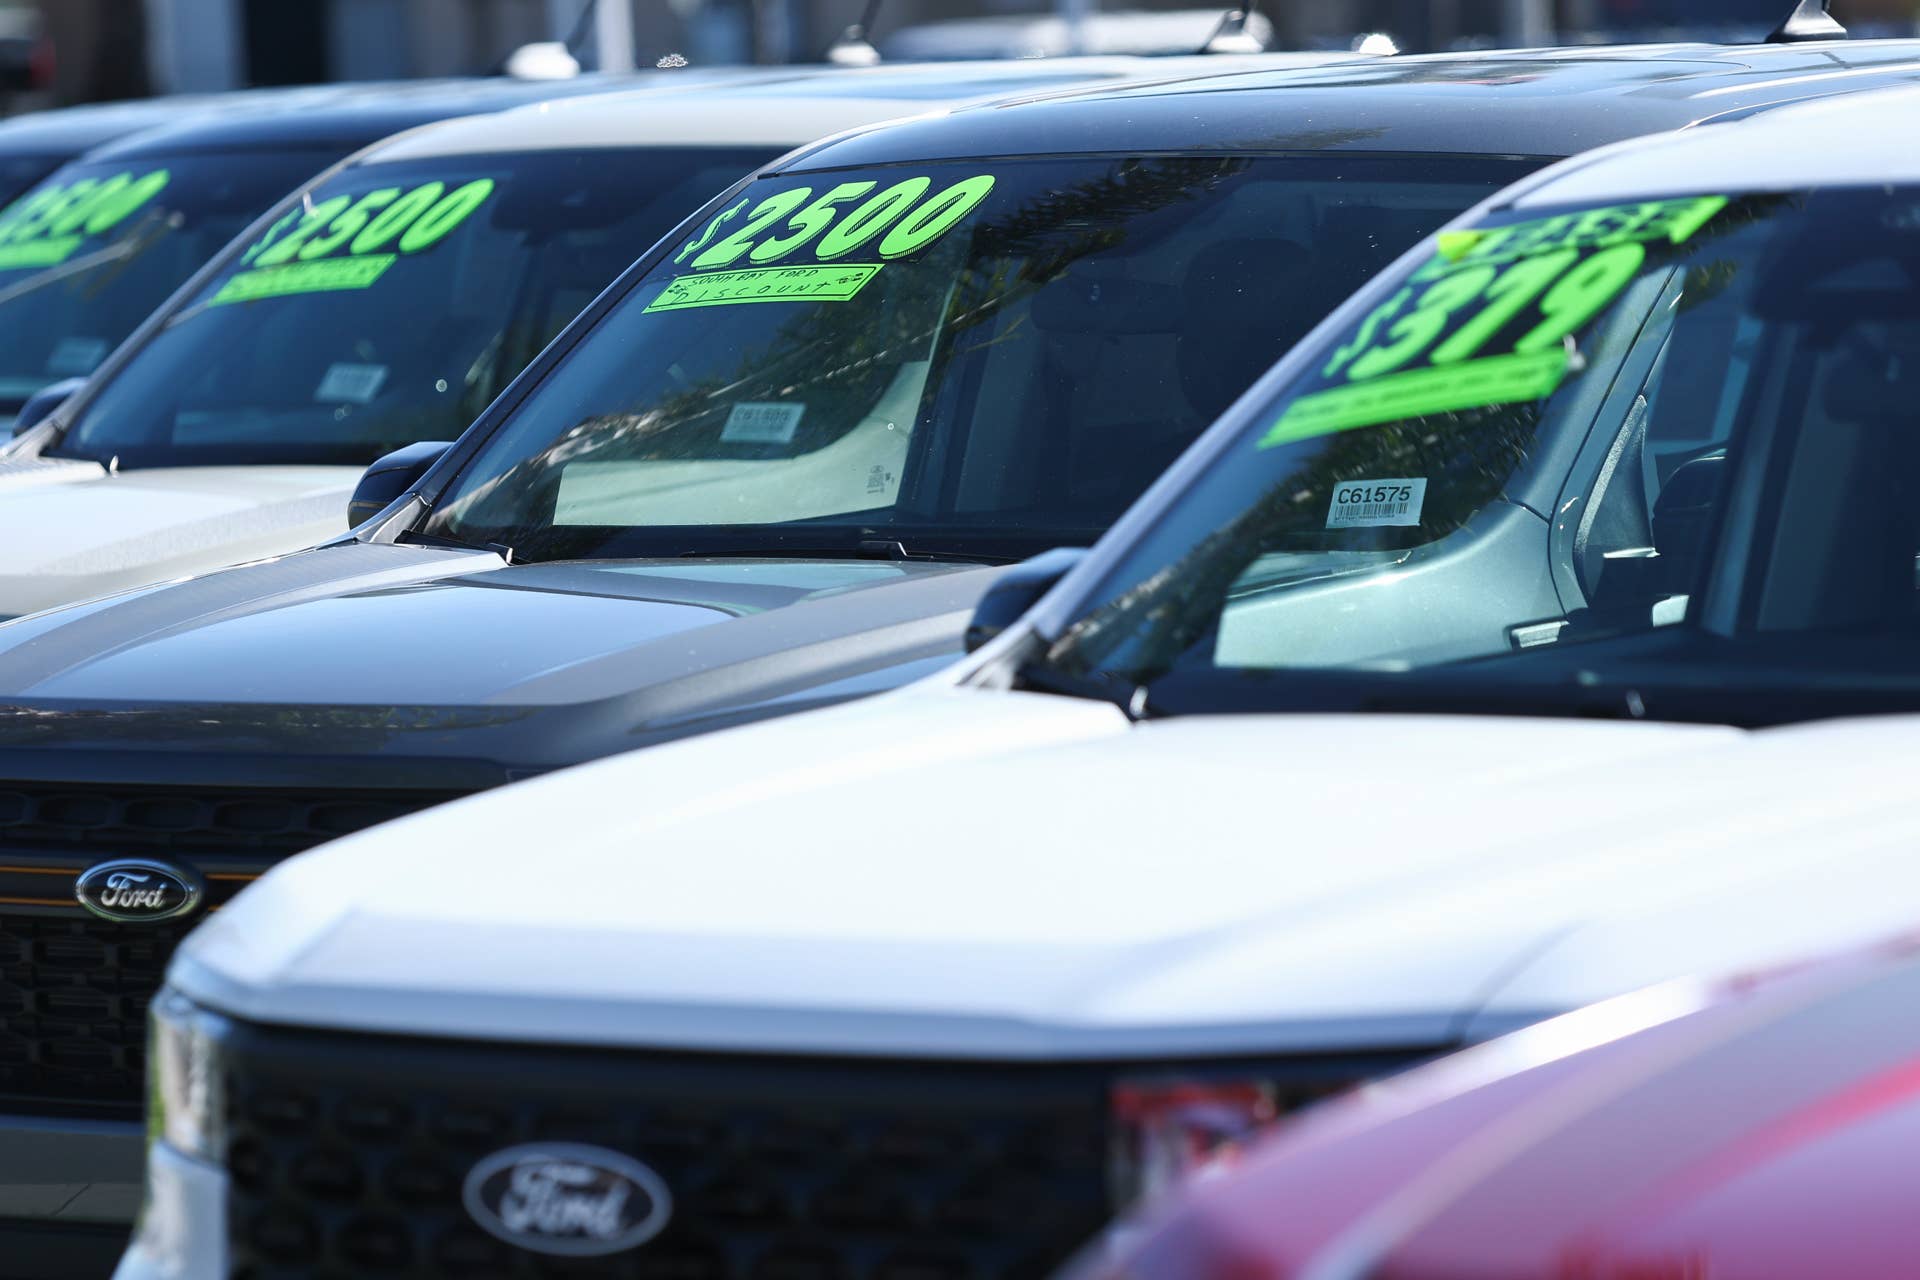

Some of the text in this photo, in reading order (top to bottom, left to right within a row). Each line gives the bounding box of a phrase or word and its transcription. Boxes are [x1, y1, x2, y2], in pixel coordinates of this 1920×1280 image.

[240, 178, 494, 267] $2500
[674, 175, 996, 270] $2500
[671, 281, 832, 303] DISCOUNT
[688, 269, 820, 287] SOUTH BAY FORD
[1337, 486, 1413, 504] C61575
[100, 871, 168, 909] Ford
[500, 1160, 631, 1240] Ford
